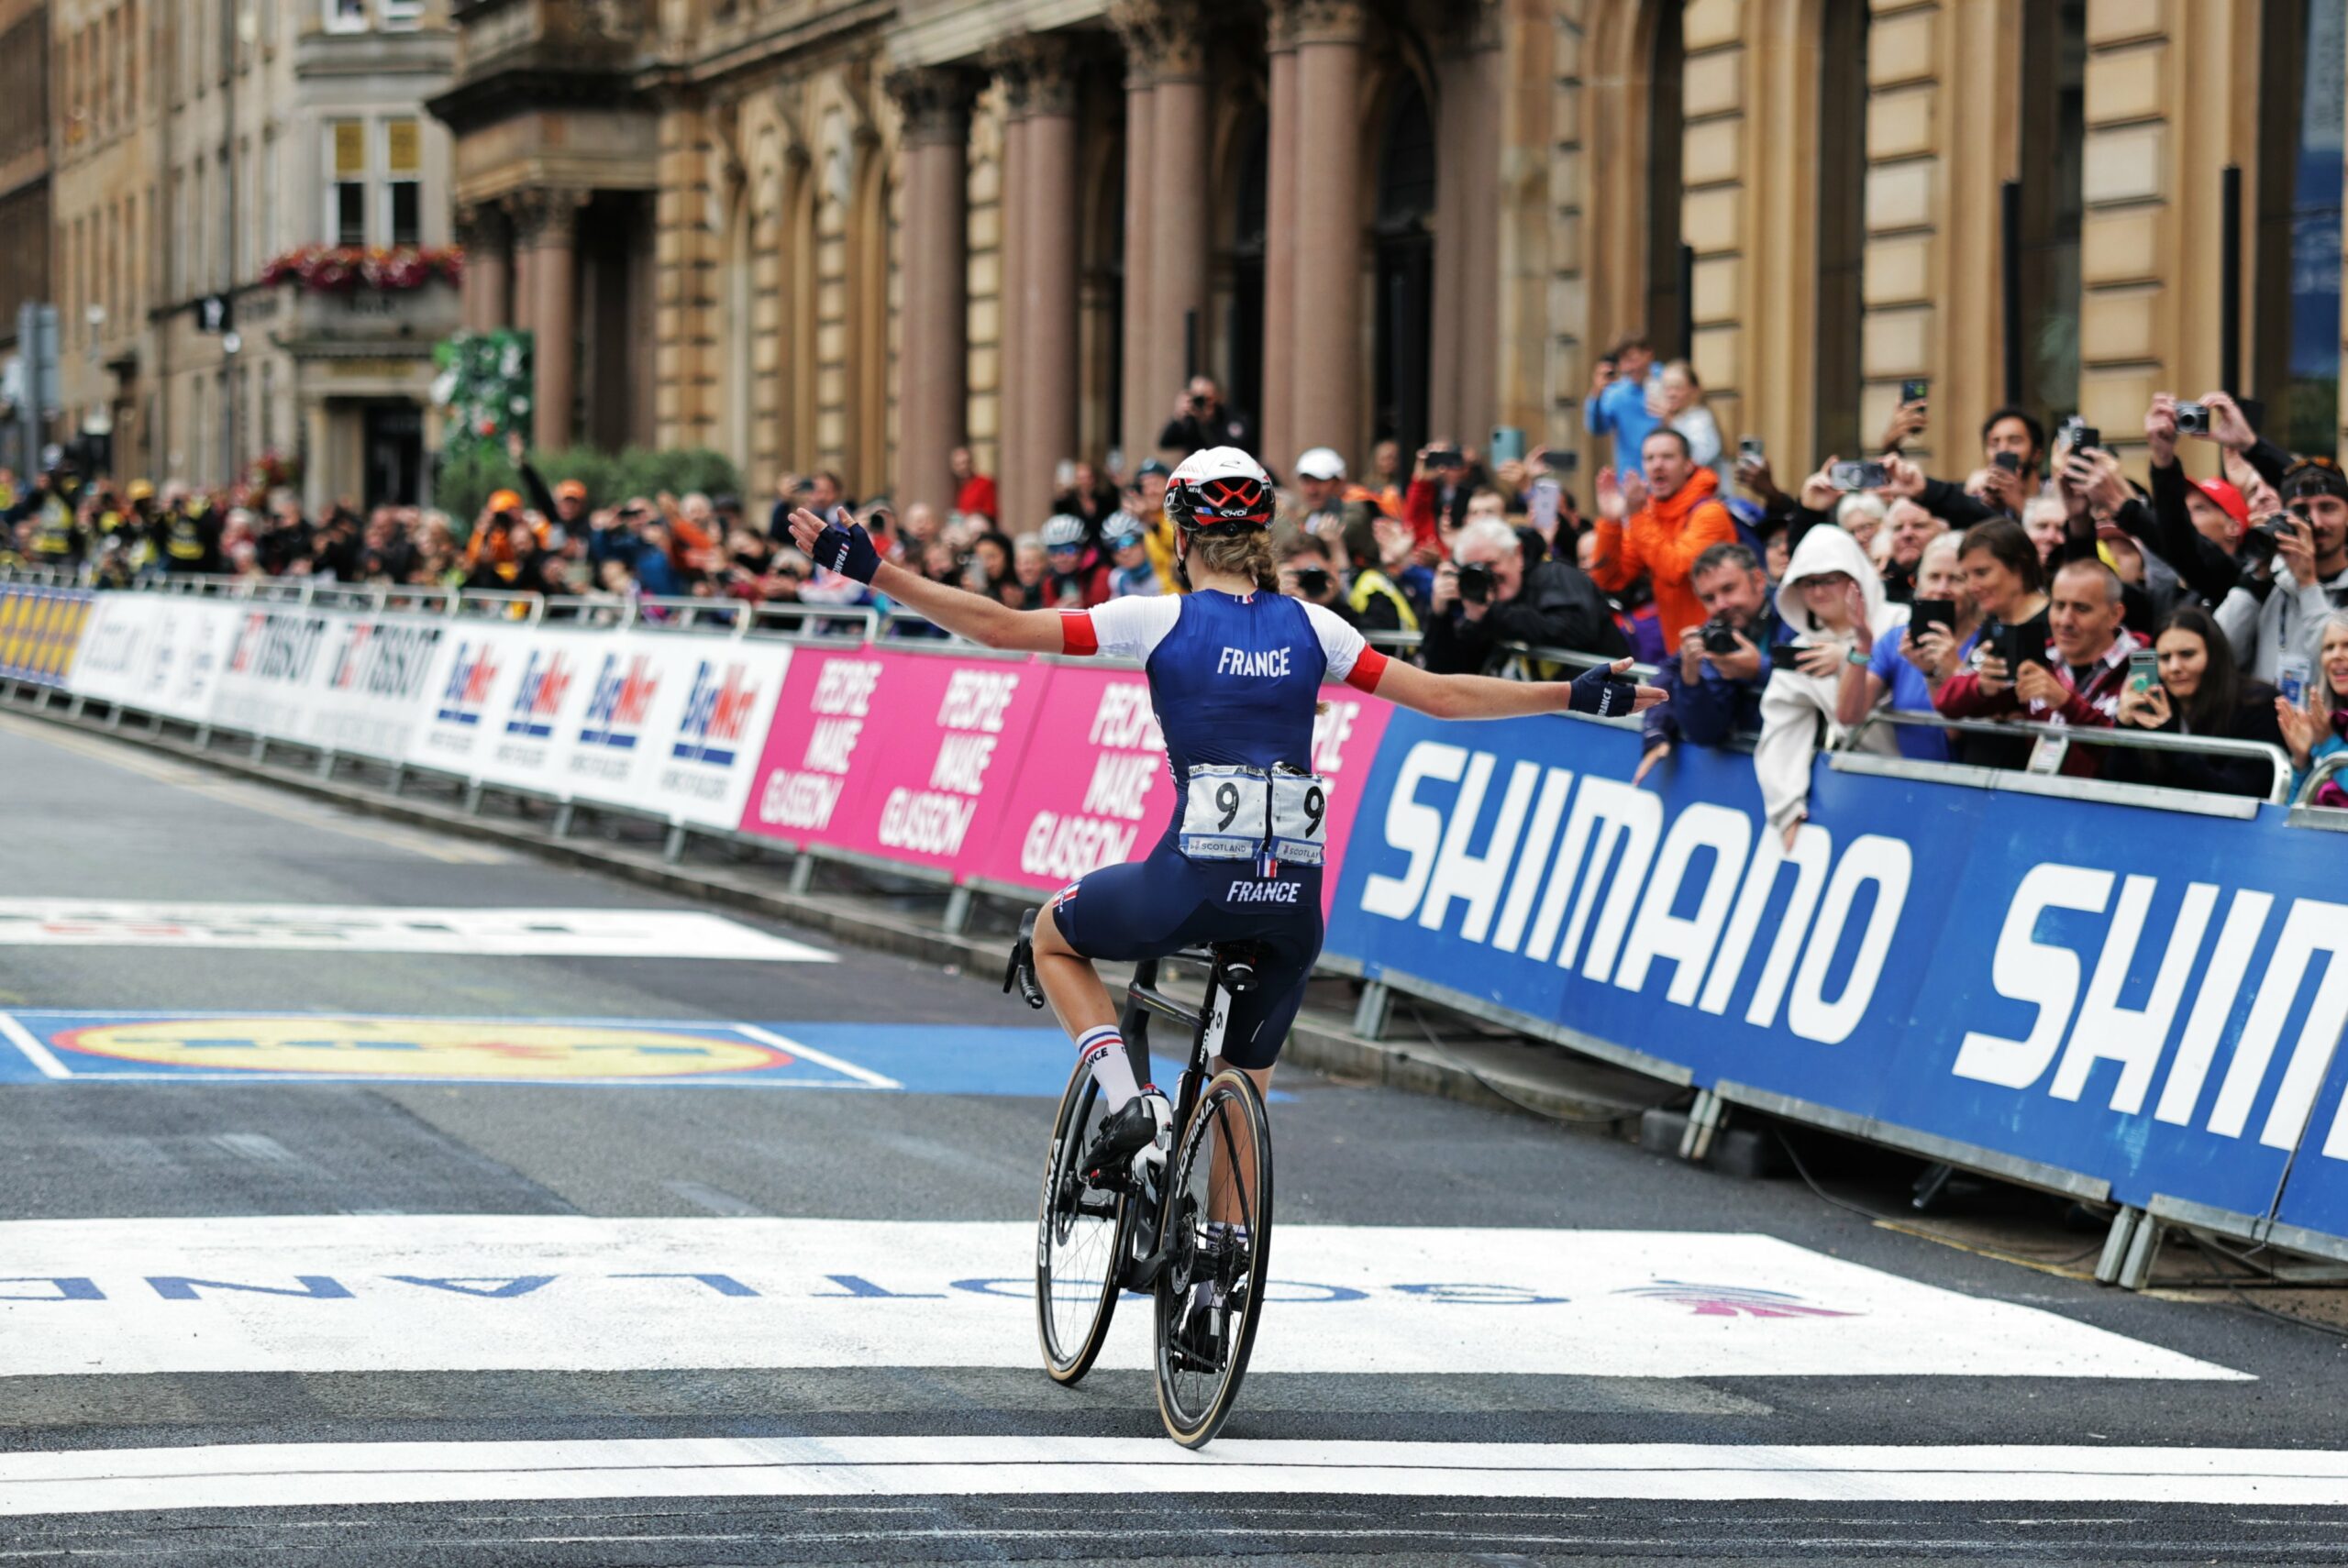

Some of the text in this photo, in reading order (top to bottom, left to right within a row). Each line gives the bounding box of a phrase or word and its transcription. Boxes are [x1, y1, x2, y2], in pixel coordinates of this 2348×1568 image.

[1217, 646, 1290, 678] FRANCE
[1215, 782, 1239, 833] 9
[1303, 786, 1325, 839] 9
[1202, 843, 1246, 853] SCOTLAND
[1226, 880, 1301, 902] FRANCE
[1359, 741, 1913, 1044] SHIMANO
[1039, 1139, 1062, 1268] CORIMA
